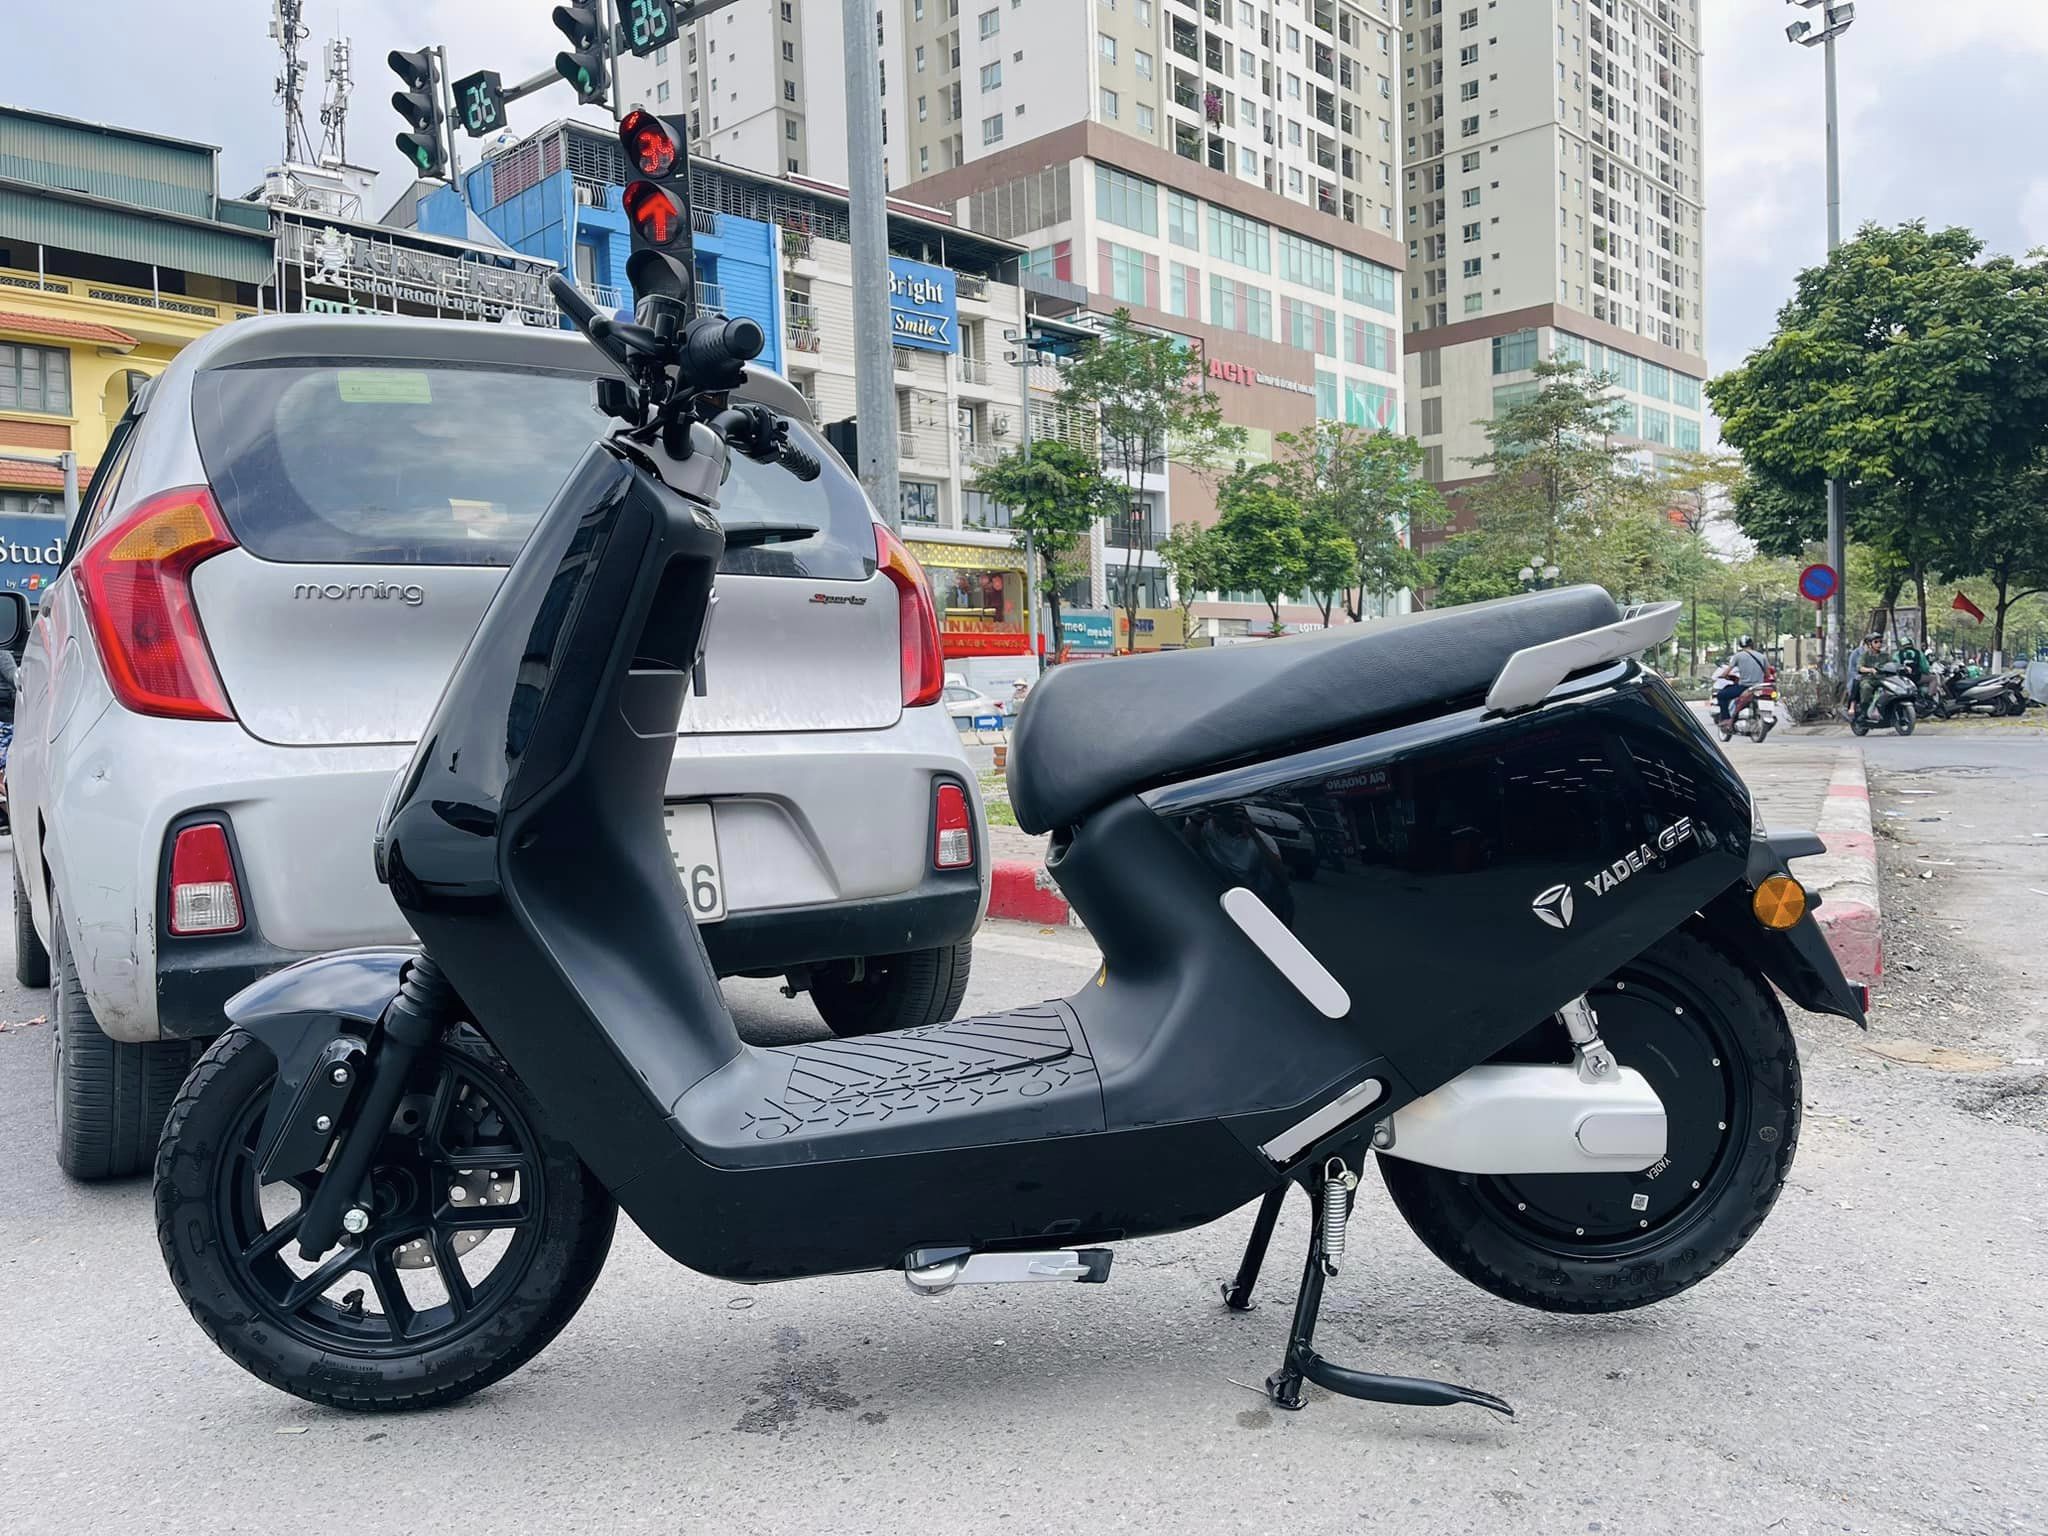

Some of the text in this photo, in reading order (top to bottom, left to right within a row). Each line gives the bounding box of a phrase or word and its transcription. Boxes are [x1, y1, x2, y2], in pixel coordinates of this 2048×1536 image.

[631, 0, 667, 46] 26
[466, 80, 496, 129] 26
[639, 131, 675, 173] 34
[888, 270, 944, 305] Bright
[895, 312, 936, 337] Smile
[0, 535, 63, 565] Stud
[293, 579, 425, 606] morning
[1584, 816, 1693, 896] YADEA G5
[1646, 1156, 1672, 1180] YADEA
